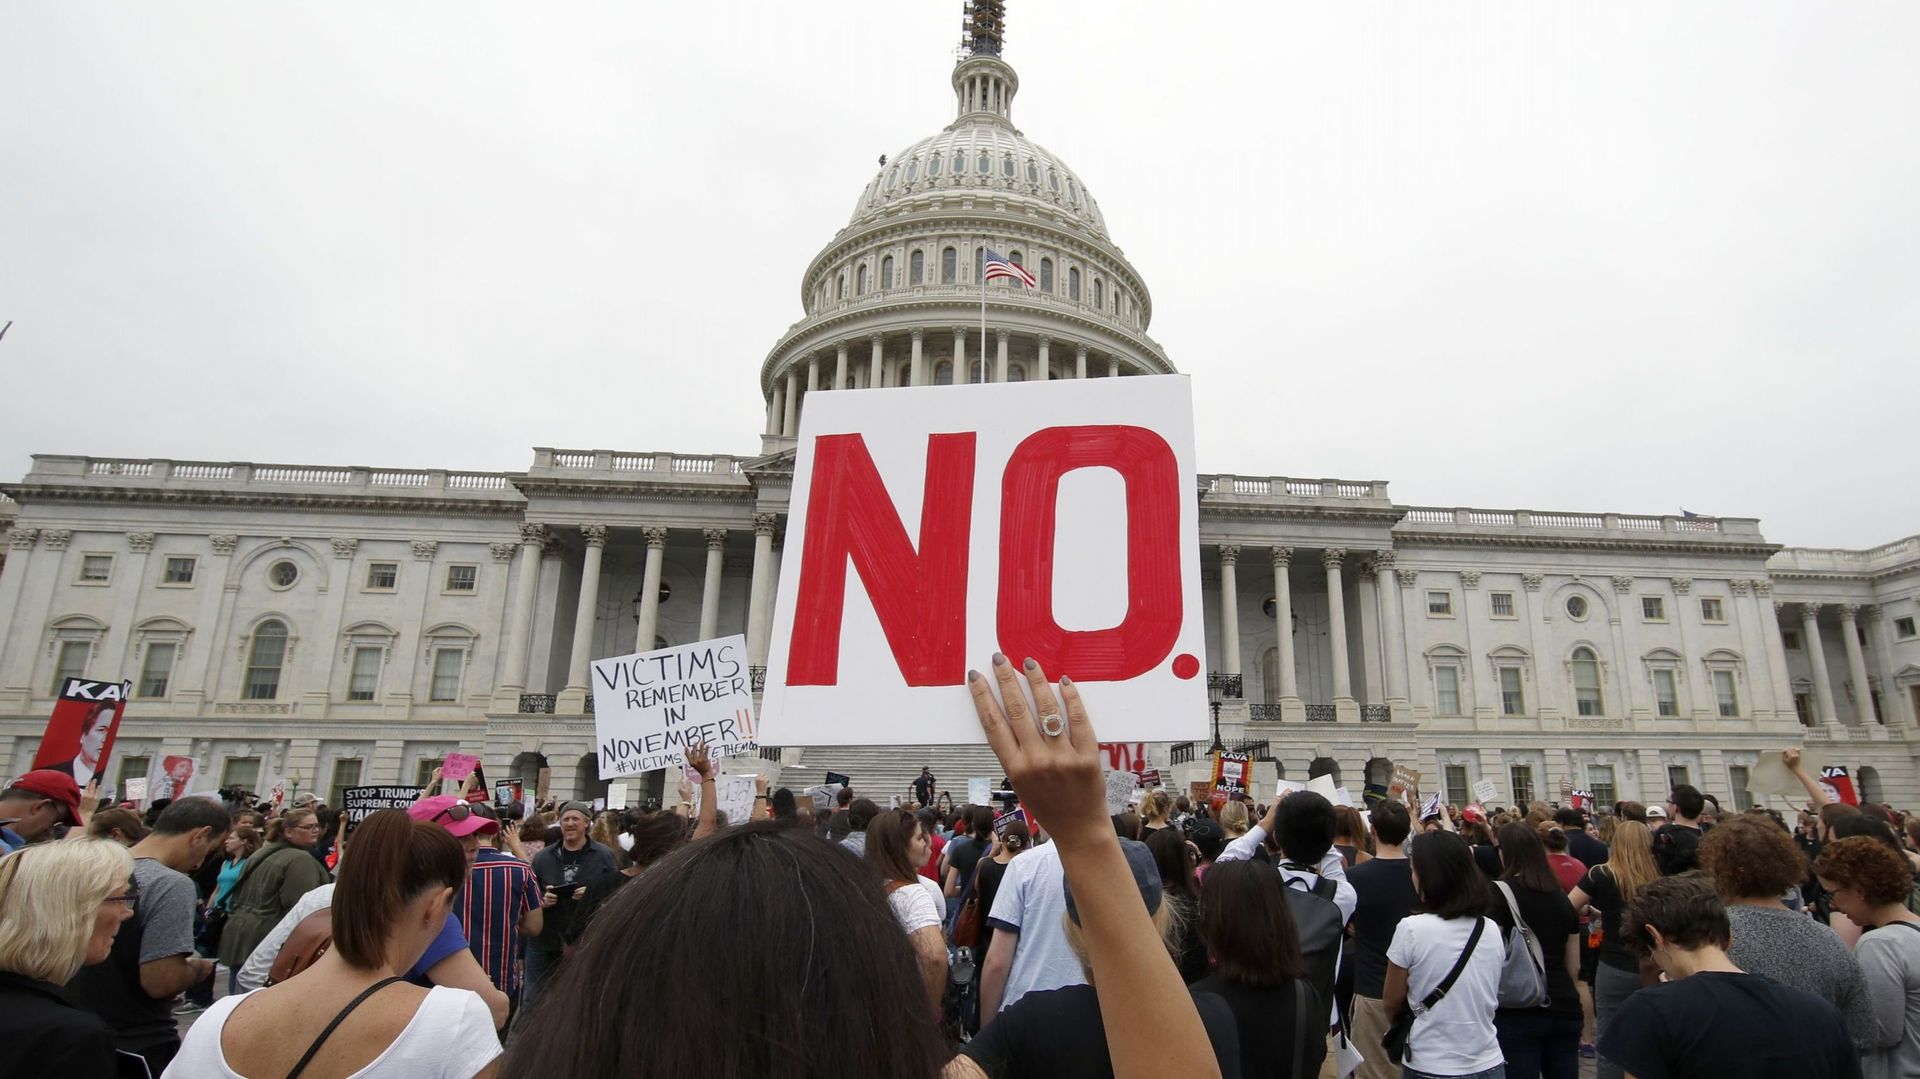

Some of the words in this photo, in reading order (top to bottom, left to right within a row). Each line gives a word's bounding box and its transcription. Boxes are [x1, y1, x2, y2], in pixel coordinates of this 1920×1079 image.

[785, 425, 1200, 687] NO.
[596, 646, 740, 690] VICTIMS
[626, 677, 749, 709] REMEMBER
[664, 705, 686, 727] IN
[616, 753, 682, 773] #VICTIMS
[1220, 752, 1248, 761] KAVA
[346, 788, 376, 799] STOP
[1217, 785, 1245, 793] NOPE
[348, 799, 391, 808] SUPREME
[393, 800, 418, 808] COU
